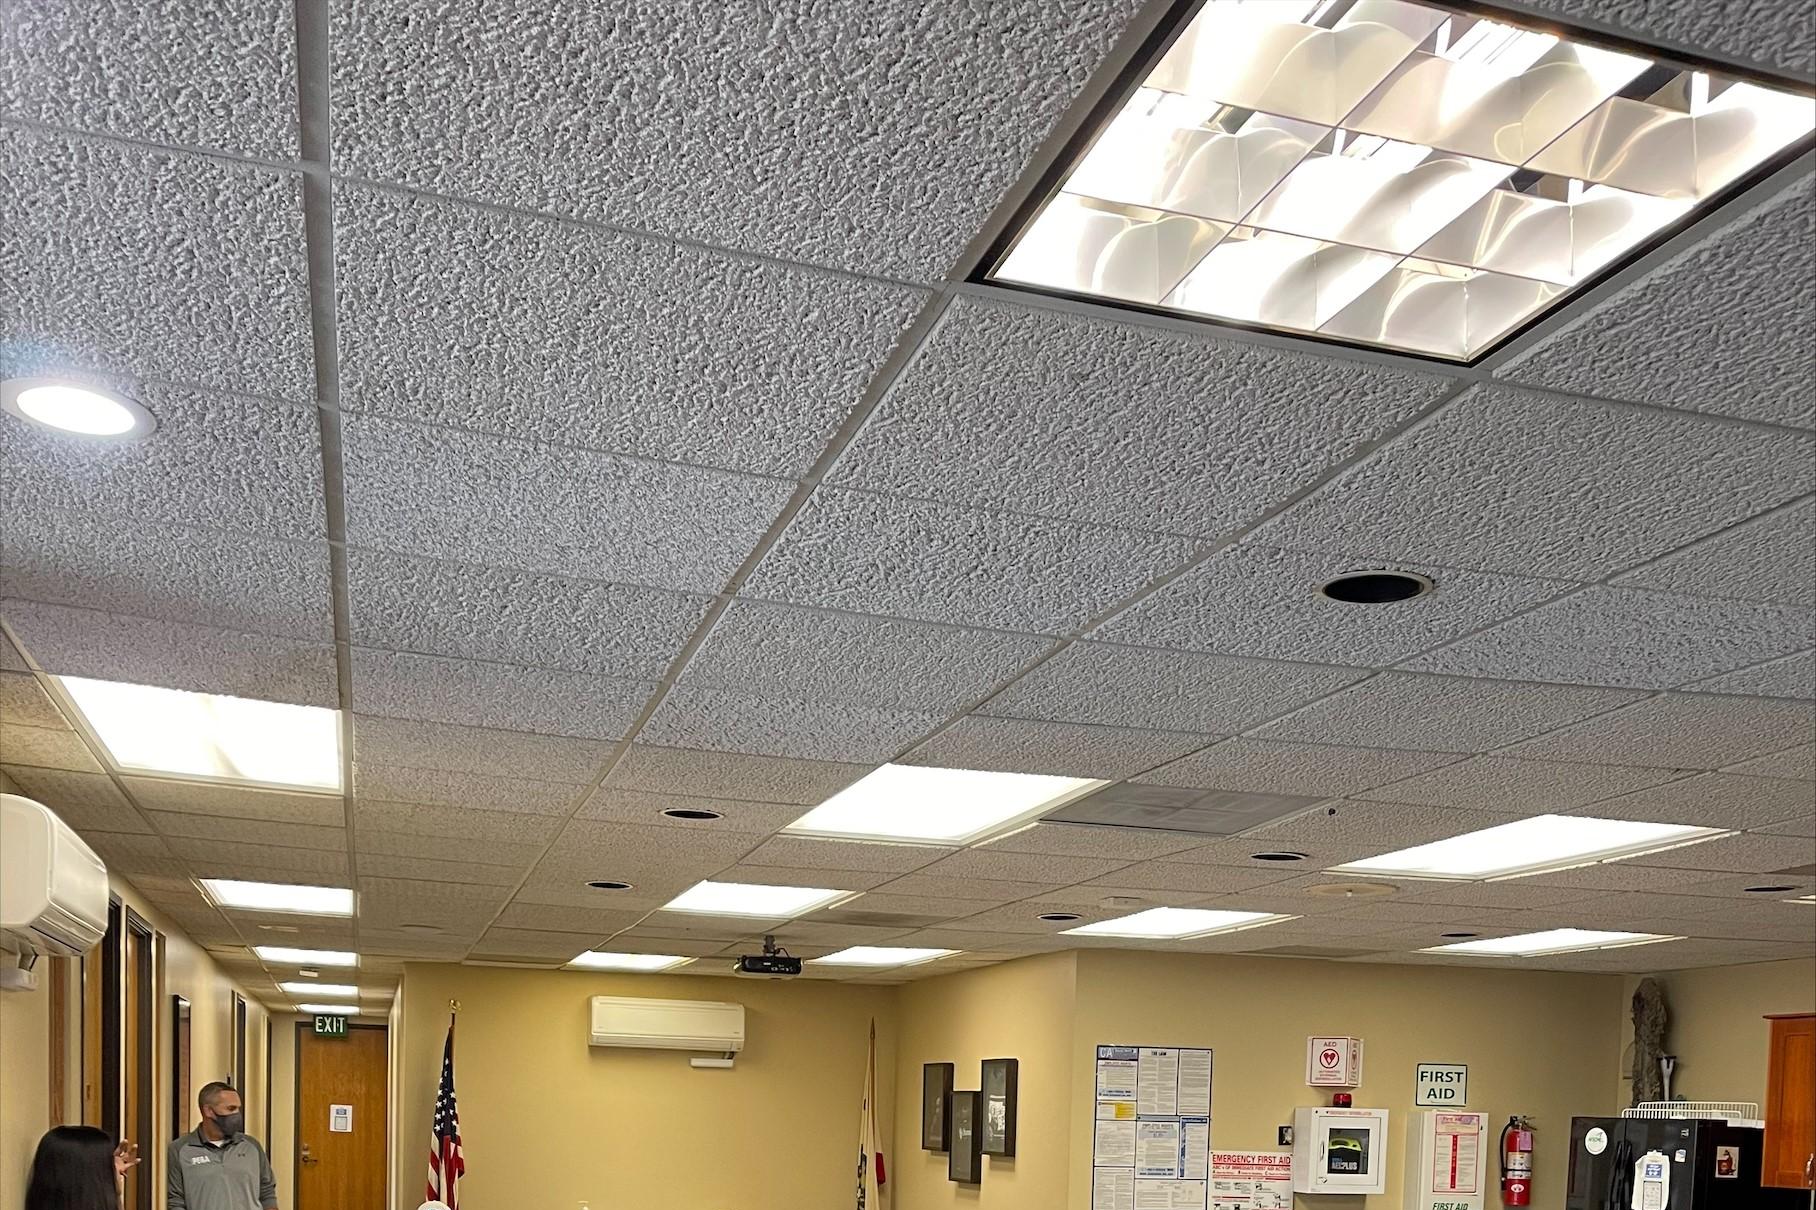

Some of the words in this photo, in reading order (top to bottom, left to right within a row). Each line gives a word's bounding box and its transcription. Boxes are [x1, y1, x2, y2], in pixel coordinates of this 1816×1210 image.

[315, 1016, 345, 1033] EXIT
[1420, 1071, 1464, 1083] FIRST
[1427, 1088, 1455, 1099] AID
[1212, 1154, 1256, 1163] EMERGENCY
[1258, 1156, 1276, 1164] FIRST
[1432, 1202, 1455, 1210] FIRST
[1455, 1203, 1469, 1210] AID
